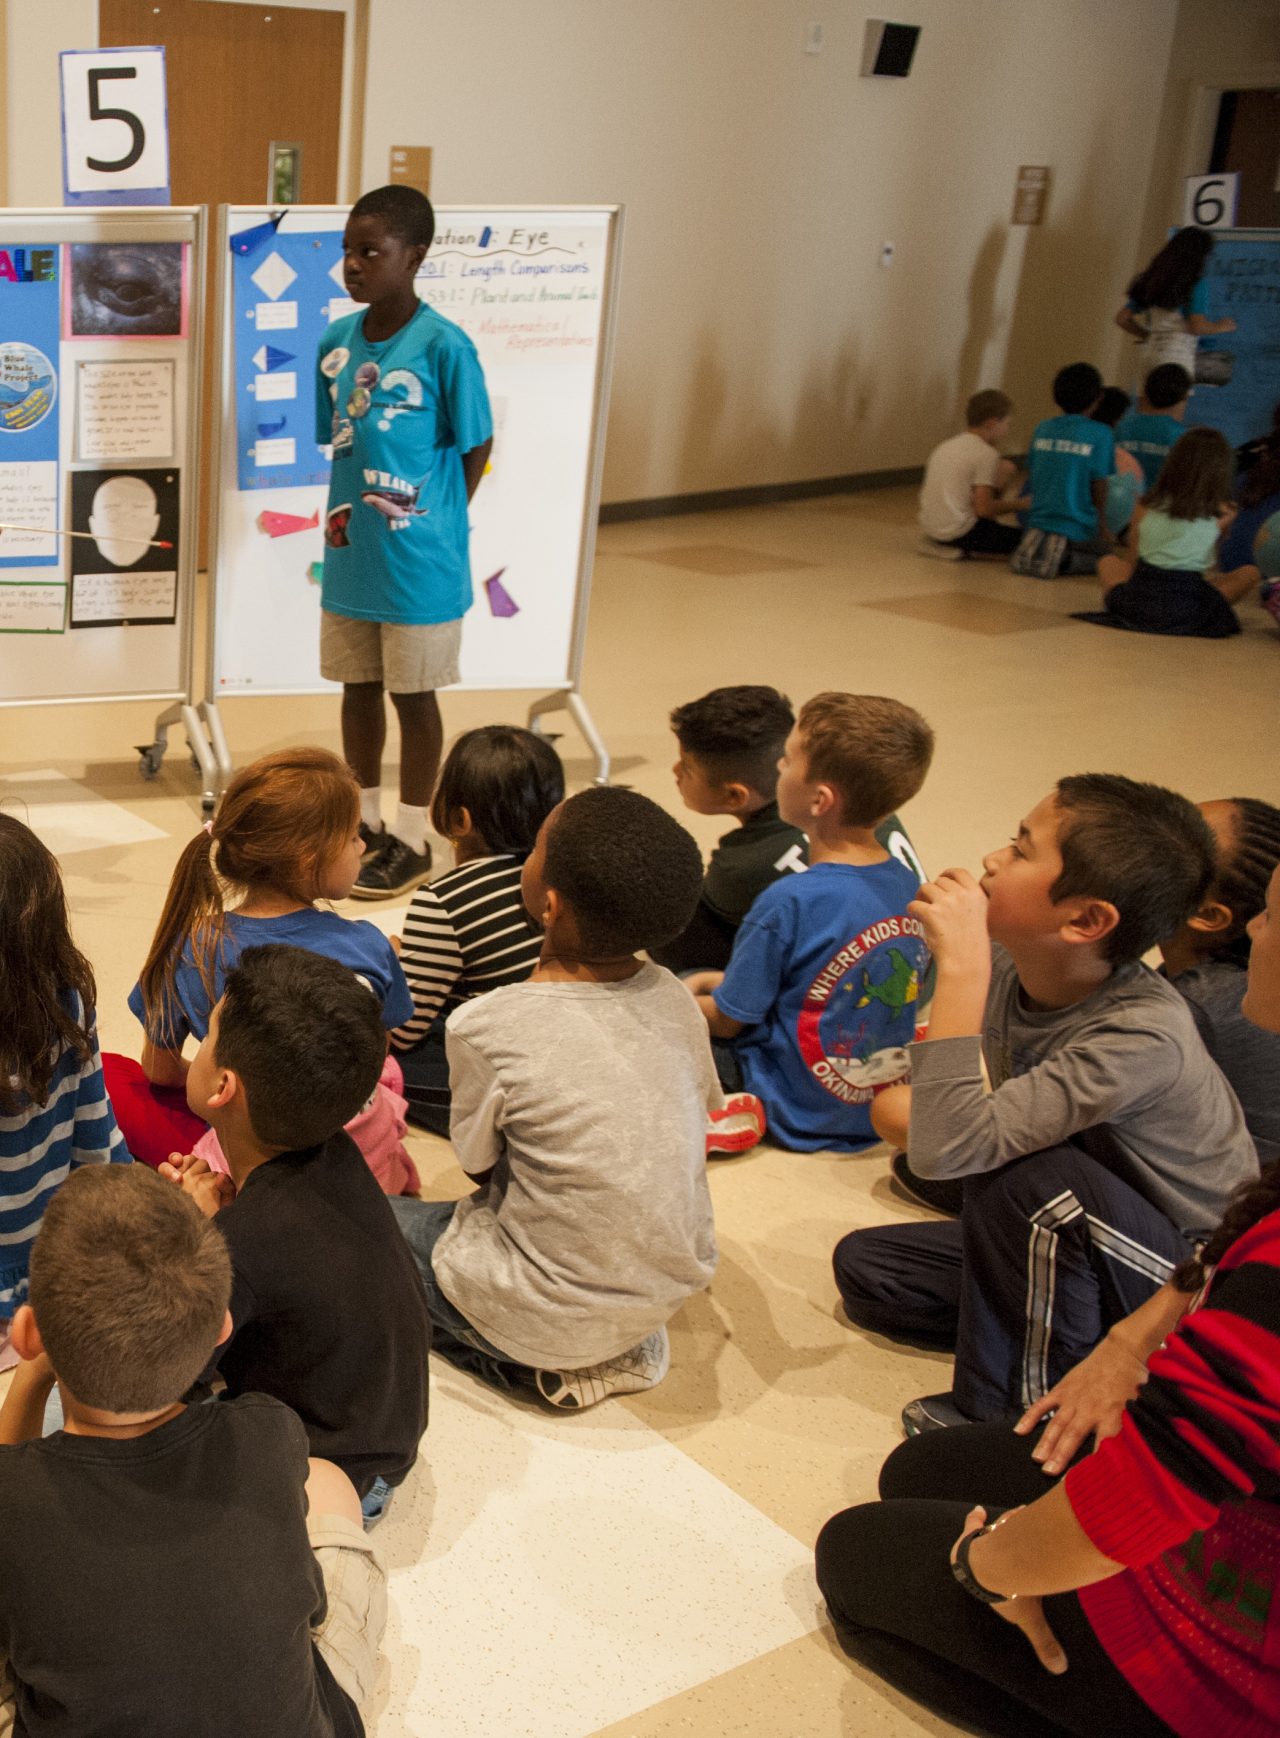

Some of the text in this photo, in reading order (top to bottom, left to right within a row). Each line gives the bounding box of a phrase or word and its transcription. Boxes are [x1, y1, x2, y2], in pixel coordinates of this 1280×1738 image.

[86, 66, 145, 172] 5
[1192, 180, 1226, 226] 6
[432, 228, 476, 245] ation
[508, 228, 549, 249] Eye
[460, 261, 505, 281] Length
[809, 940, 865, 1002] WHERE
[861, 918, 900, 949] KIDS
